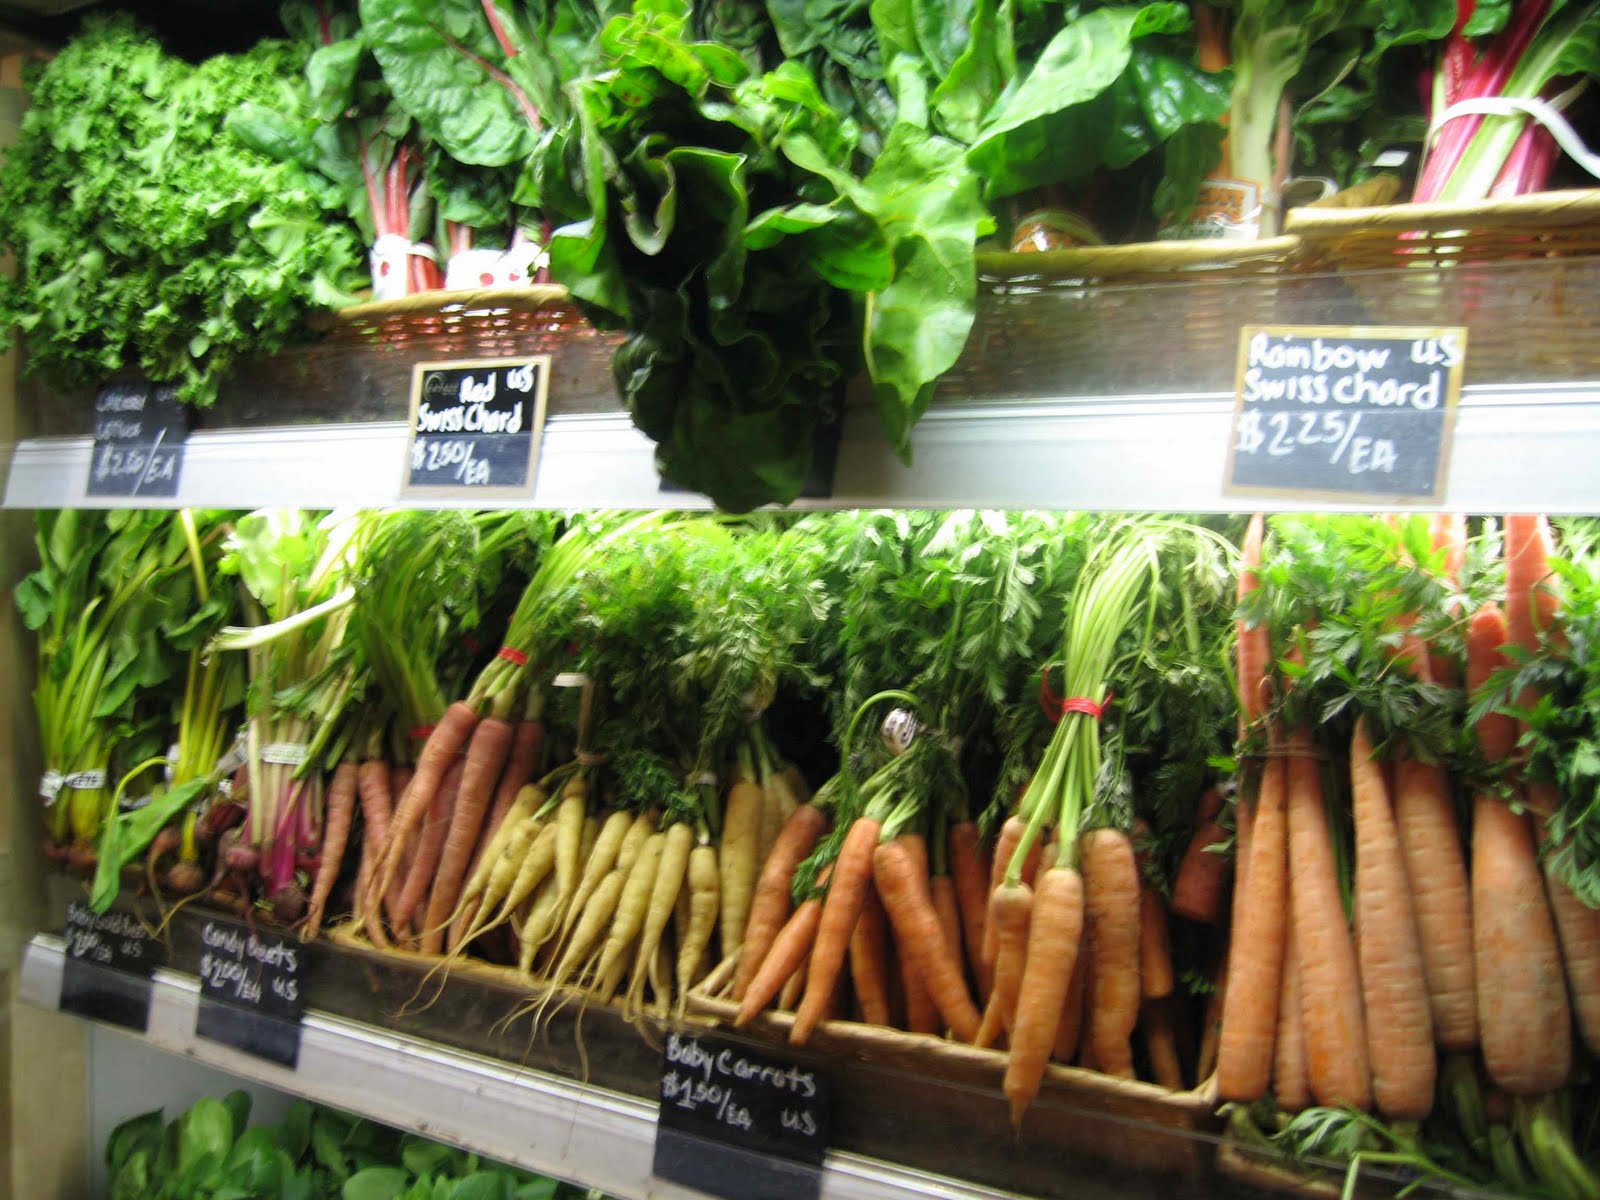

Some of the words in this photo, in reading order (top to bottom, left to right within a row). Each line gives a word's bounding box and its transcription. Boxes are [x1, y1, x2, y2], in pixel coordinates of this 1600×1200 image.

[1249, 332, 1391, 372] Rainbow
[459, 371, 497, 403] Red
[1241, 367, 1329, 404] Swiss
[666, 1034, 715, 1081] Baby
[716, 1049, 817, 1098] Carrots
